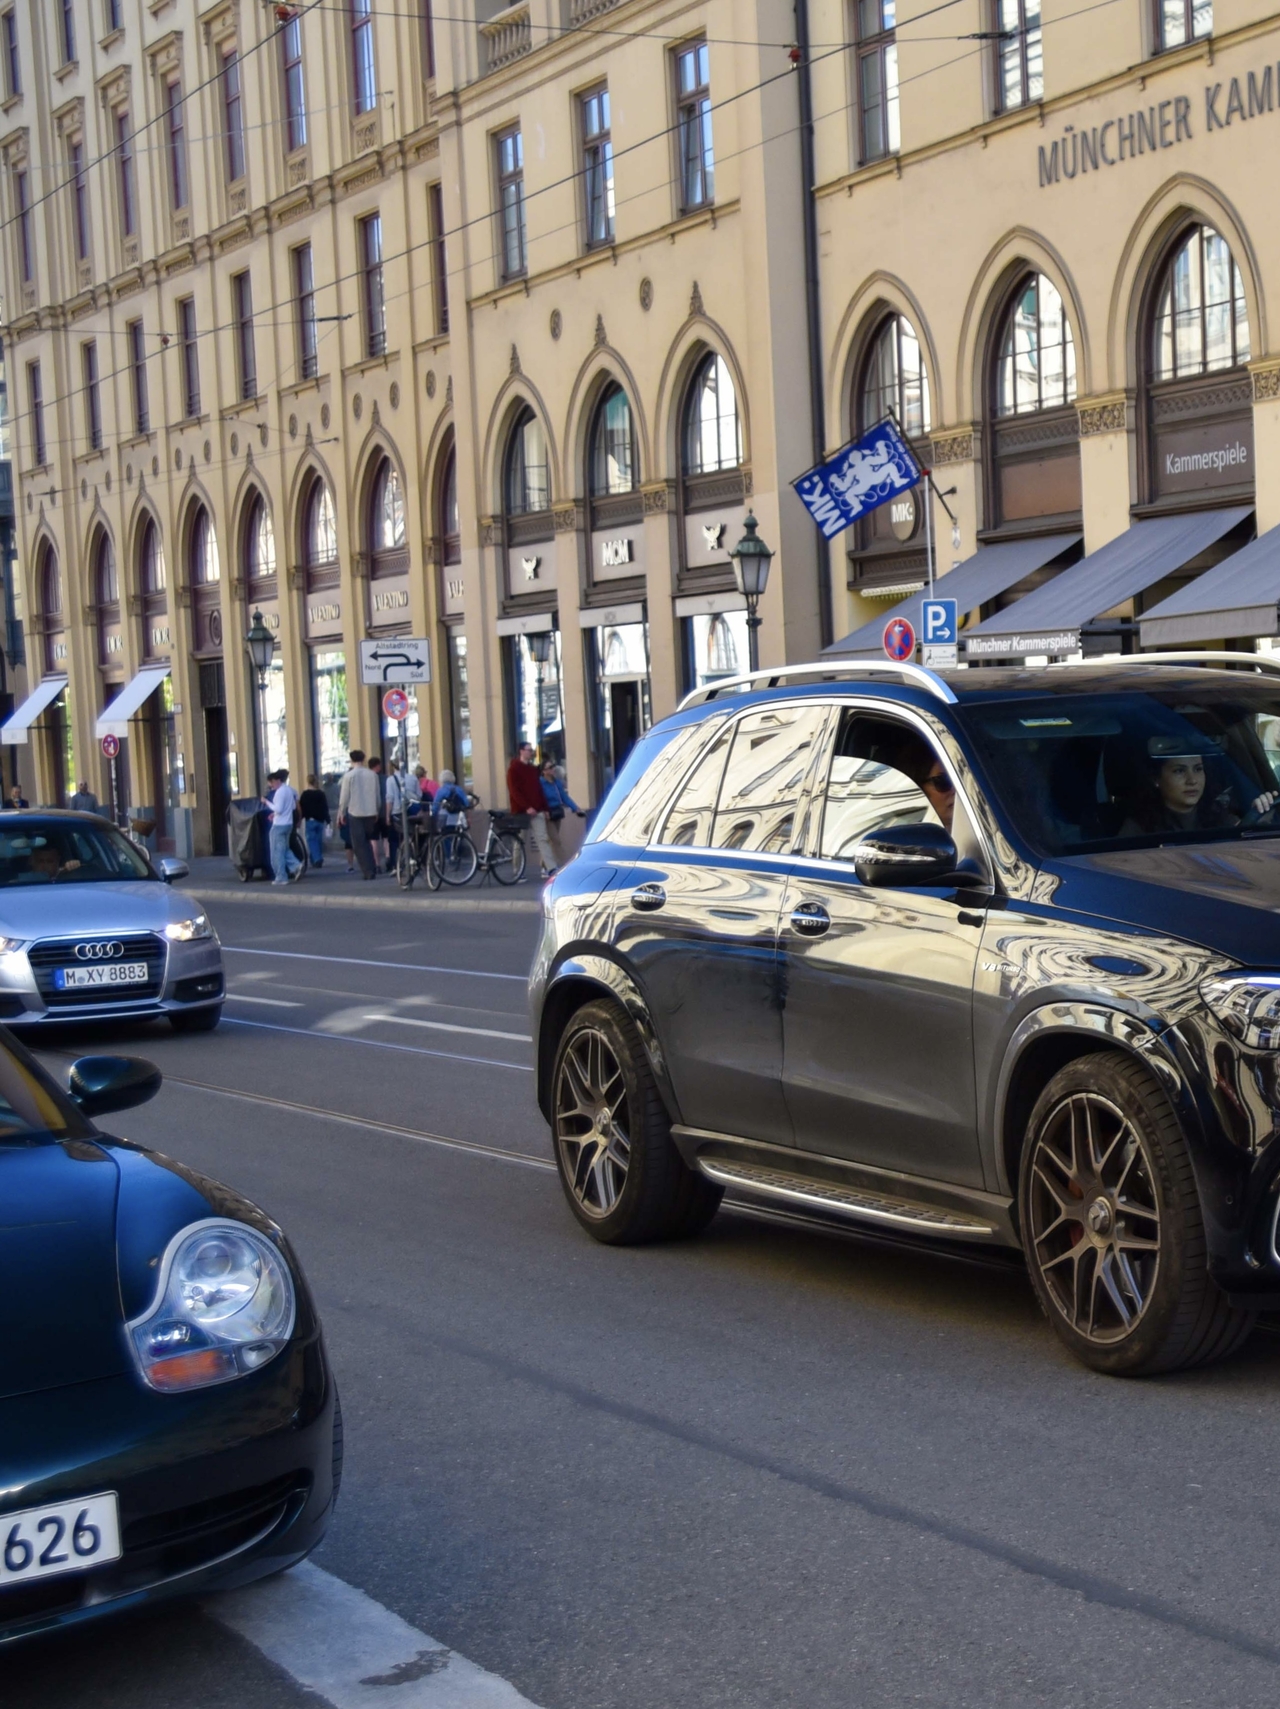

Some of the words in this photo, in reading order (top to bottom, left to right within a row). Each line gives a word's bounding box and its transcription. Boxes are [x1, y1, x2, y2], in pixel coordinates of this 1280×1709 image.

[1037, 96, 1193, 188] MÜNCHNER
[1166, 440, 1247, 474] Kammerspiele
[801, 474, 847, 537] MK:
[891, 502, 913, 524] MK:
[602, 538, 630, 567] MCM
[373, 590, 409, 611] VALENTINO
[309, 604, 340, 624] VALENTINO
[926, 605, 946, 640] P
[375, 642, 419, 651] Altstadtring
[968, 637, 1012, 654] Münchner
[1012, 632, 1077, 653] Kammerspiele
[65, 970, 77, 986] M
[86, 968, 106, 983] XY
[109, 964, 146, 982] 8883
[4, 1507, 102, 1572] 626
